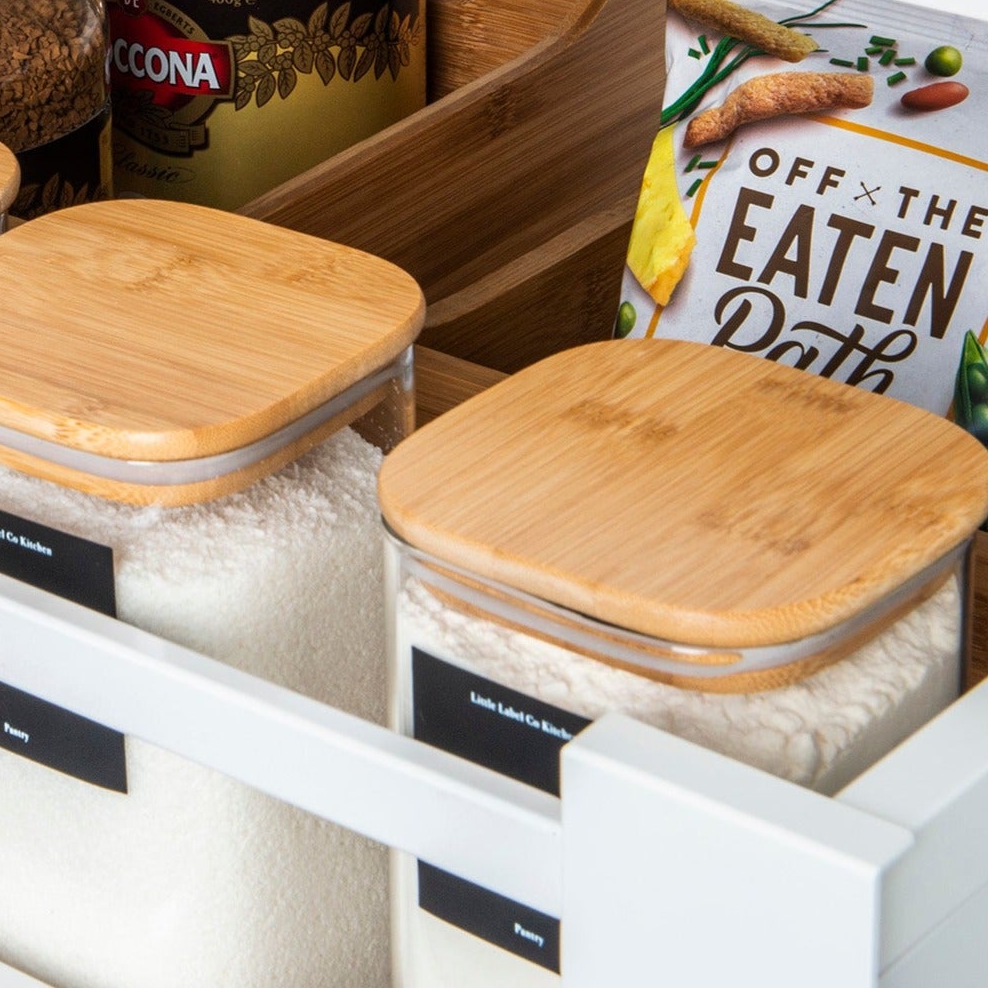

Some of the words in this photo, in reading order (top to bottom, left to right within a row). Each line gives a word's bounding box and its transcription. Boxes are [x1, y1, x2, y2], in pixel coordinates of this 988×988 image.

[153, 1, 196, 35] EGBERTS
[104, 38, 220, 90] CCONA
[748, 147, 846, 196] OFF
[896, 185, 988, 240] THE
[715, 186, 974, 340] EATEN
[6, 531, 19, 545] Co
[19, 536, 53, 557] Kitchen
[470, 690, 496, 712] Little
[498, 701, 524, 724] Label
[525, 713, 540, 730] Co
[3, 721, 30, 744] Pantry
[514, 922, 544, 948] Pantry
